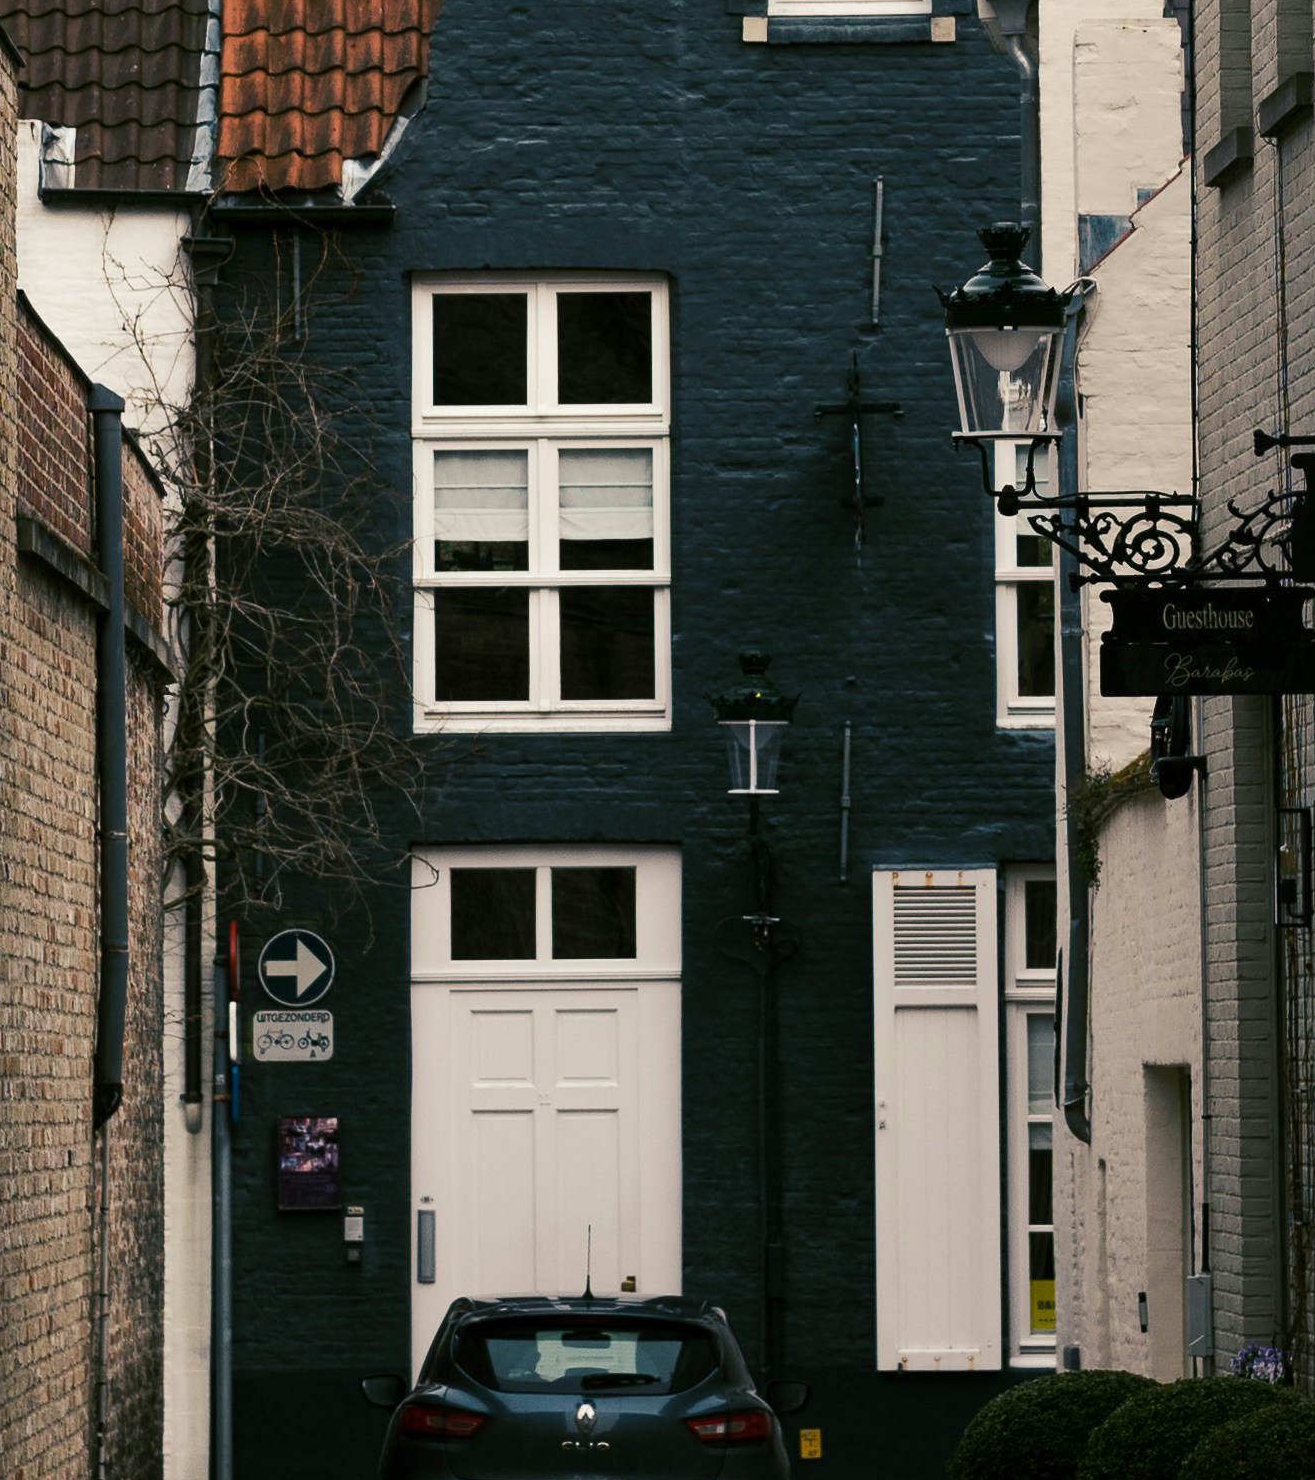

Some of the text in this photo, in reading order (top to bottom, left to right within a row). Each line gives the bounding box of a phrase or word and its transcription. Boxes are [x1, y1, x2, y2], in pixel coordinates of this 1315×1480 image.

[1162, 602, 1254, 630] Guesthouse
[1164, 652, 1257, 687] Barabas
[256, 1012, 330, 1023] UITGEZONDERD
[309, 1049, 316, 1058] A
[561, 1440, 610, 1450] CLIO
